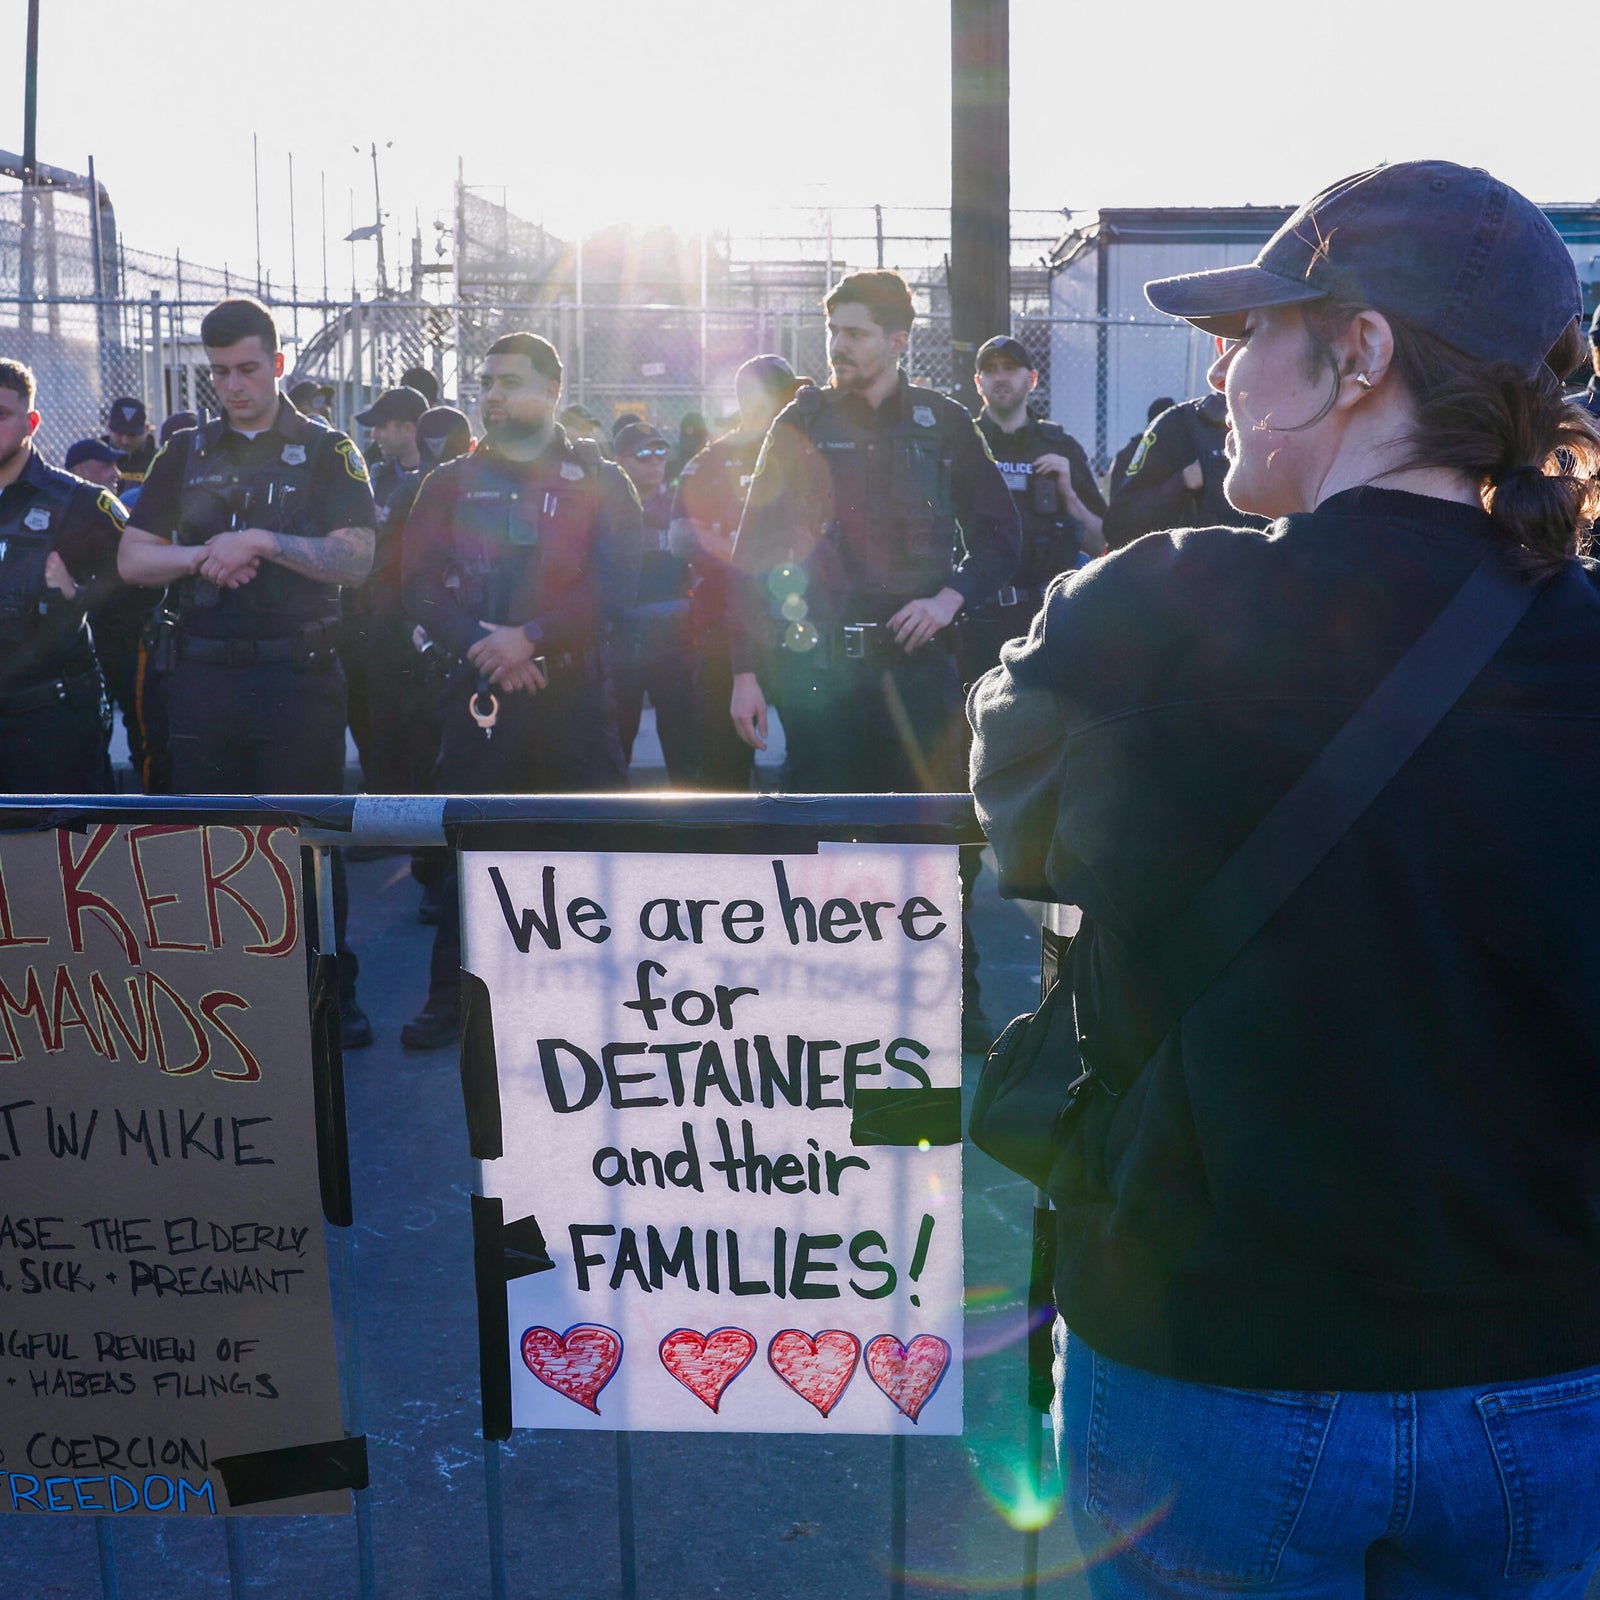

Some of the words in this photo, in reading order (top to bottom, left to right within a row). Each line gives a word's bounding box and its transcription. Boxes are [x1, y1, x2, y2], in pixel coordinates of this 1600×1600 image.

[996, 462, 1033, 474] POLICE
[488, 866, 611, 953] We
[640, 899, 764, 944] are
[772, 860, 947, 945] here
[0, 963, 261, 1082] MANDS
[623, 960, 759, 1030] for
[537, 1034, 931, 1113] DETAINEES
[47, 1106, 98, 1161] W/
[115, 1109, 275, 1166] MIKIE
[593, 1122, 703, 1192] and
[710, 1118, 870, 1195] their
[81, 1217, 156, 1253] THE
[569, 1214, 935, 1307] FAMILIES!
[129, 1260, 304, 1298] PREGNANT
[94, 1332, 195, 1362] REVIEW
[217, 1339, 260, 1363] OF
[29, 1369, 136, 1397] HABEAS
[153, 1372, 279, 1399] FILINGS
[26, 1432, 208, 1471] COERCION
